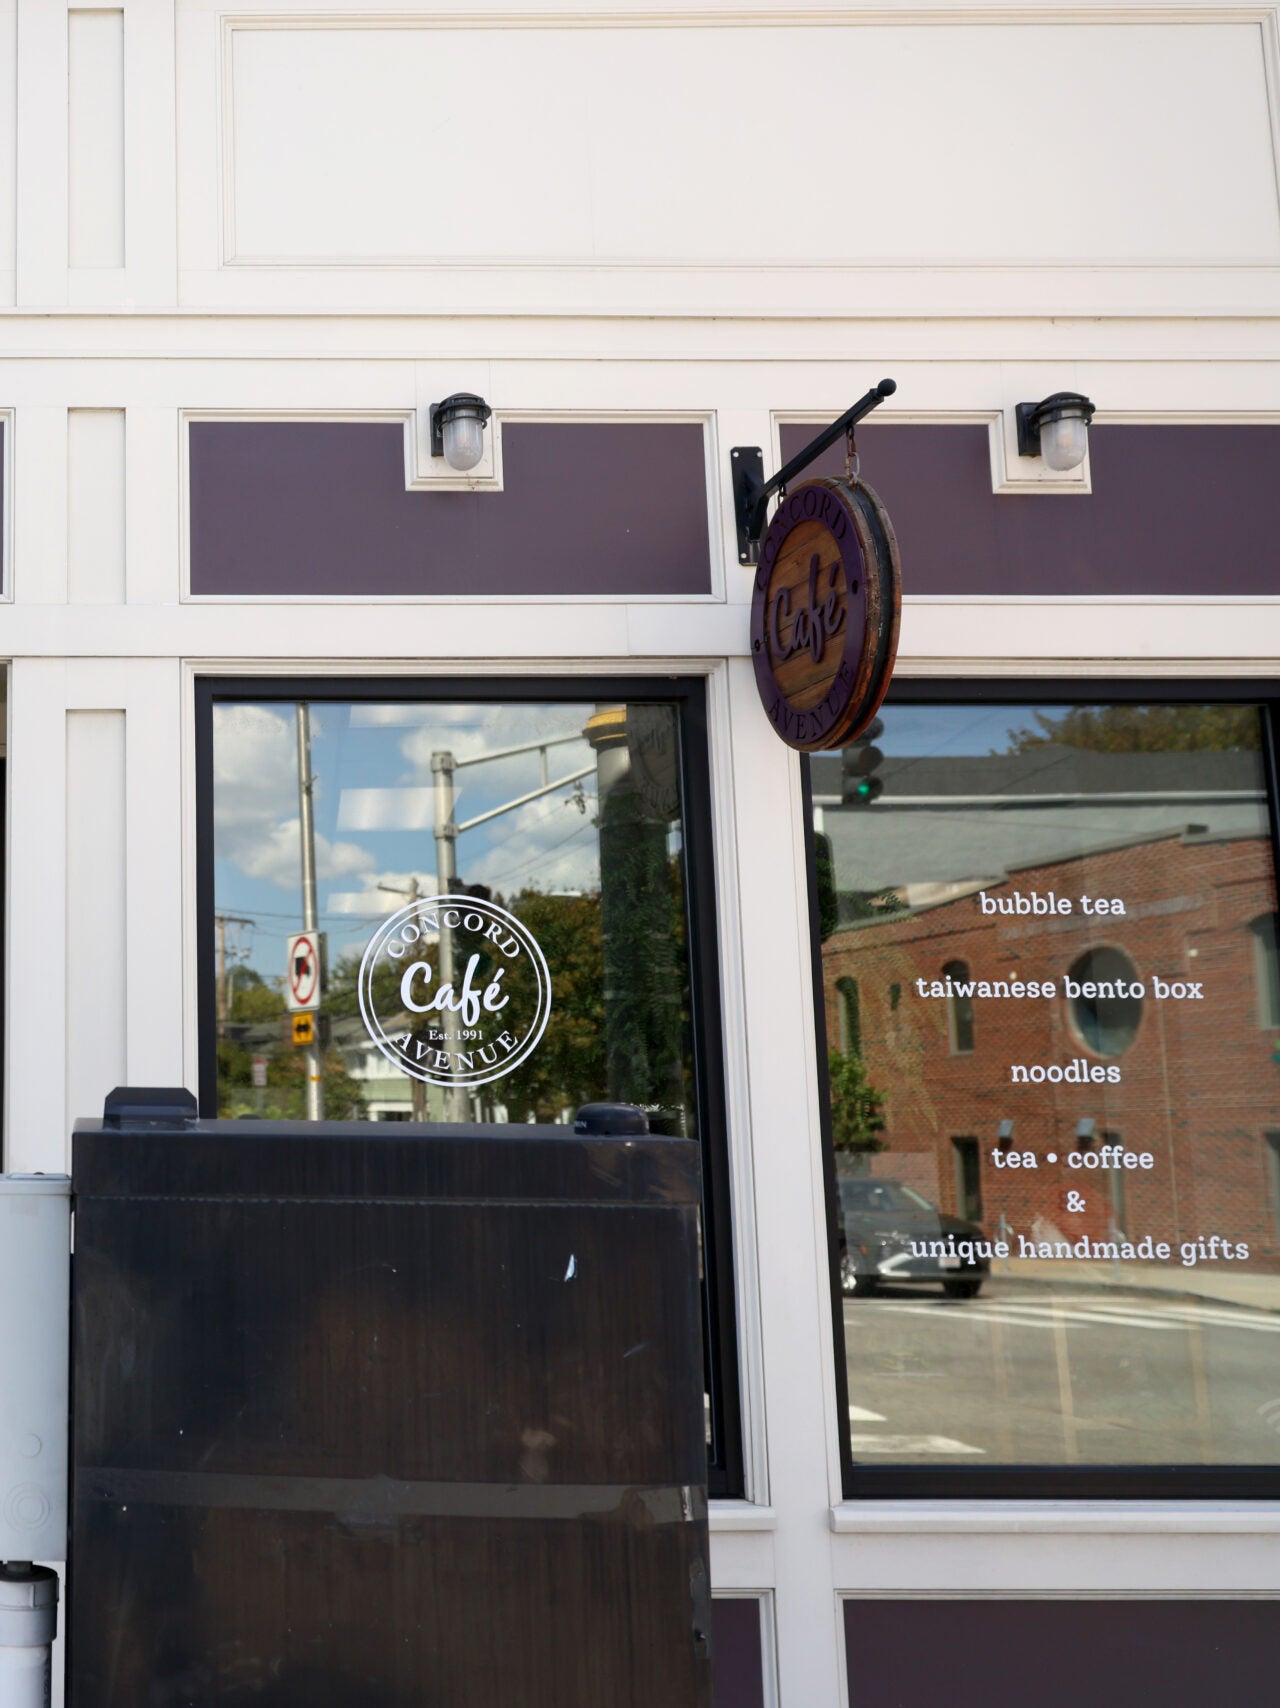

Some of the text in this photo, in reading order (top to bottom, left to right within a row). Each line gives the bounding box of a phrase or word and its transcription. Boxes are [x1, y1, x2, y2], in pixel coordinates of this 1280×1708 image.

[772, 553, 846, 664] Café
[768, 661, 854, 741] AVENUE
[980, 892, 1126, 915] bubble tea
[387, 910, 520, 959] CONCORD
[400, 953, 509, 1027] Café
[916, 976, 1204, 999] taiwanese bento box
[429, 1029, 484, 1041] Est. 1991
[395, 1030, 519, 1071] AVENUE
[1011, 1059, 1121, 1083] noodles
[992, 1145, 1154, 1169] tea coffee
[1067, 1190, 1086, 1213] &
[911, 1235, 1250, 1266] unique handmade gifts
